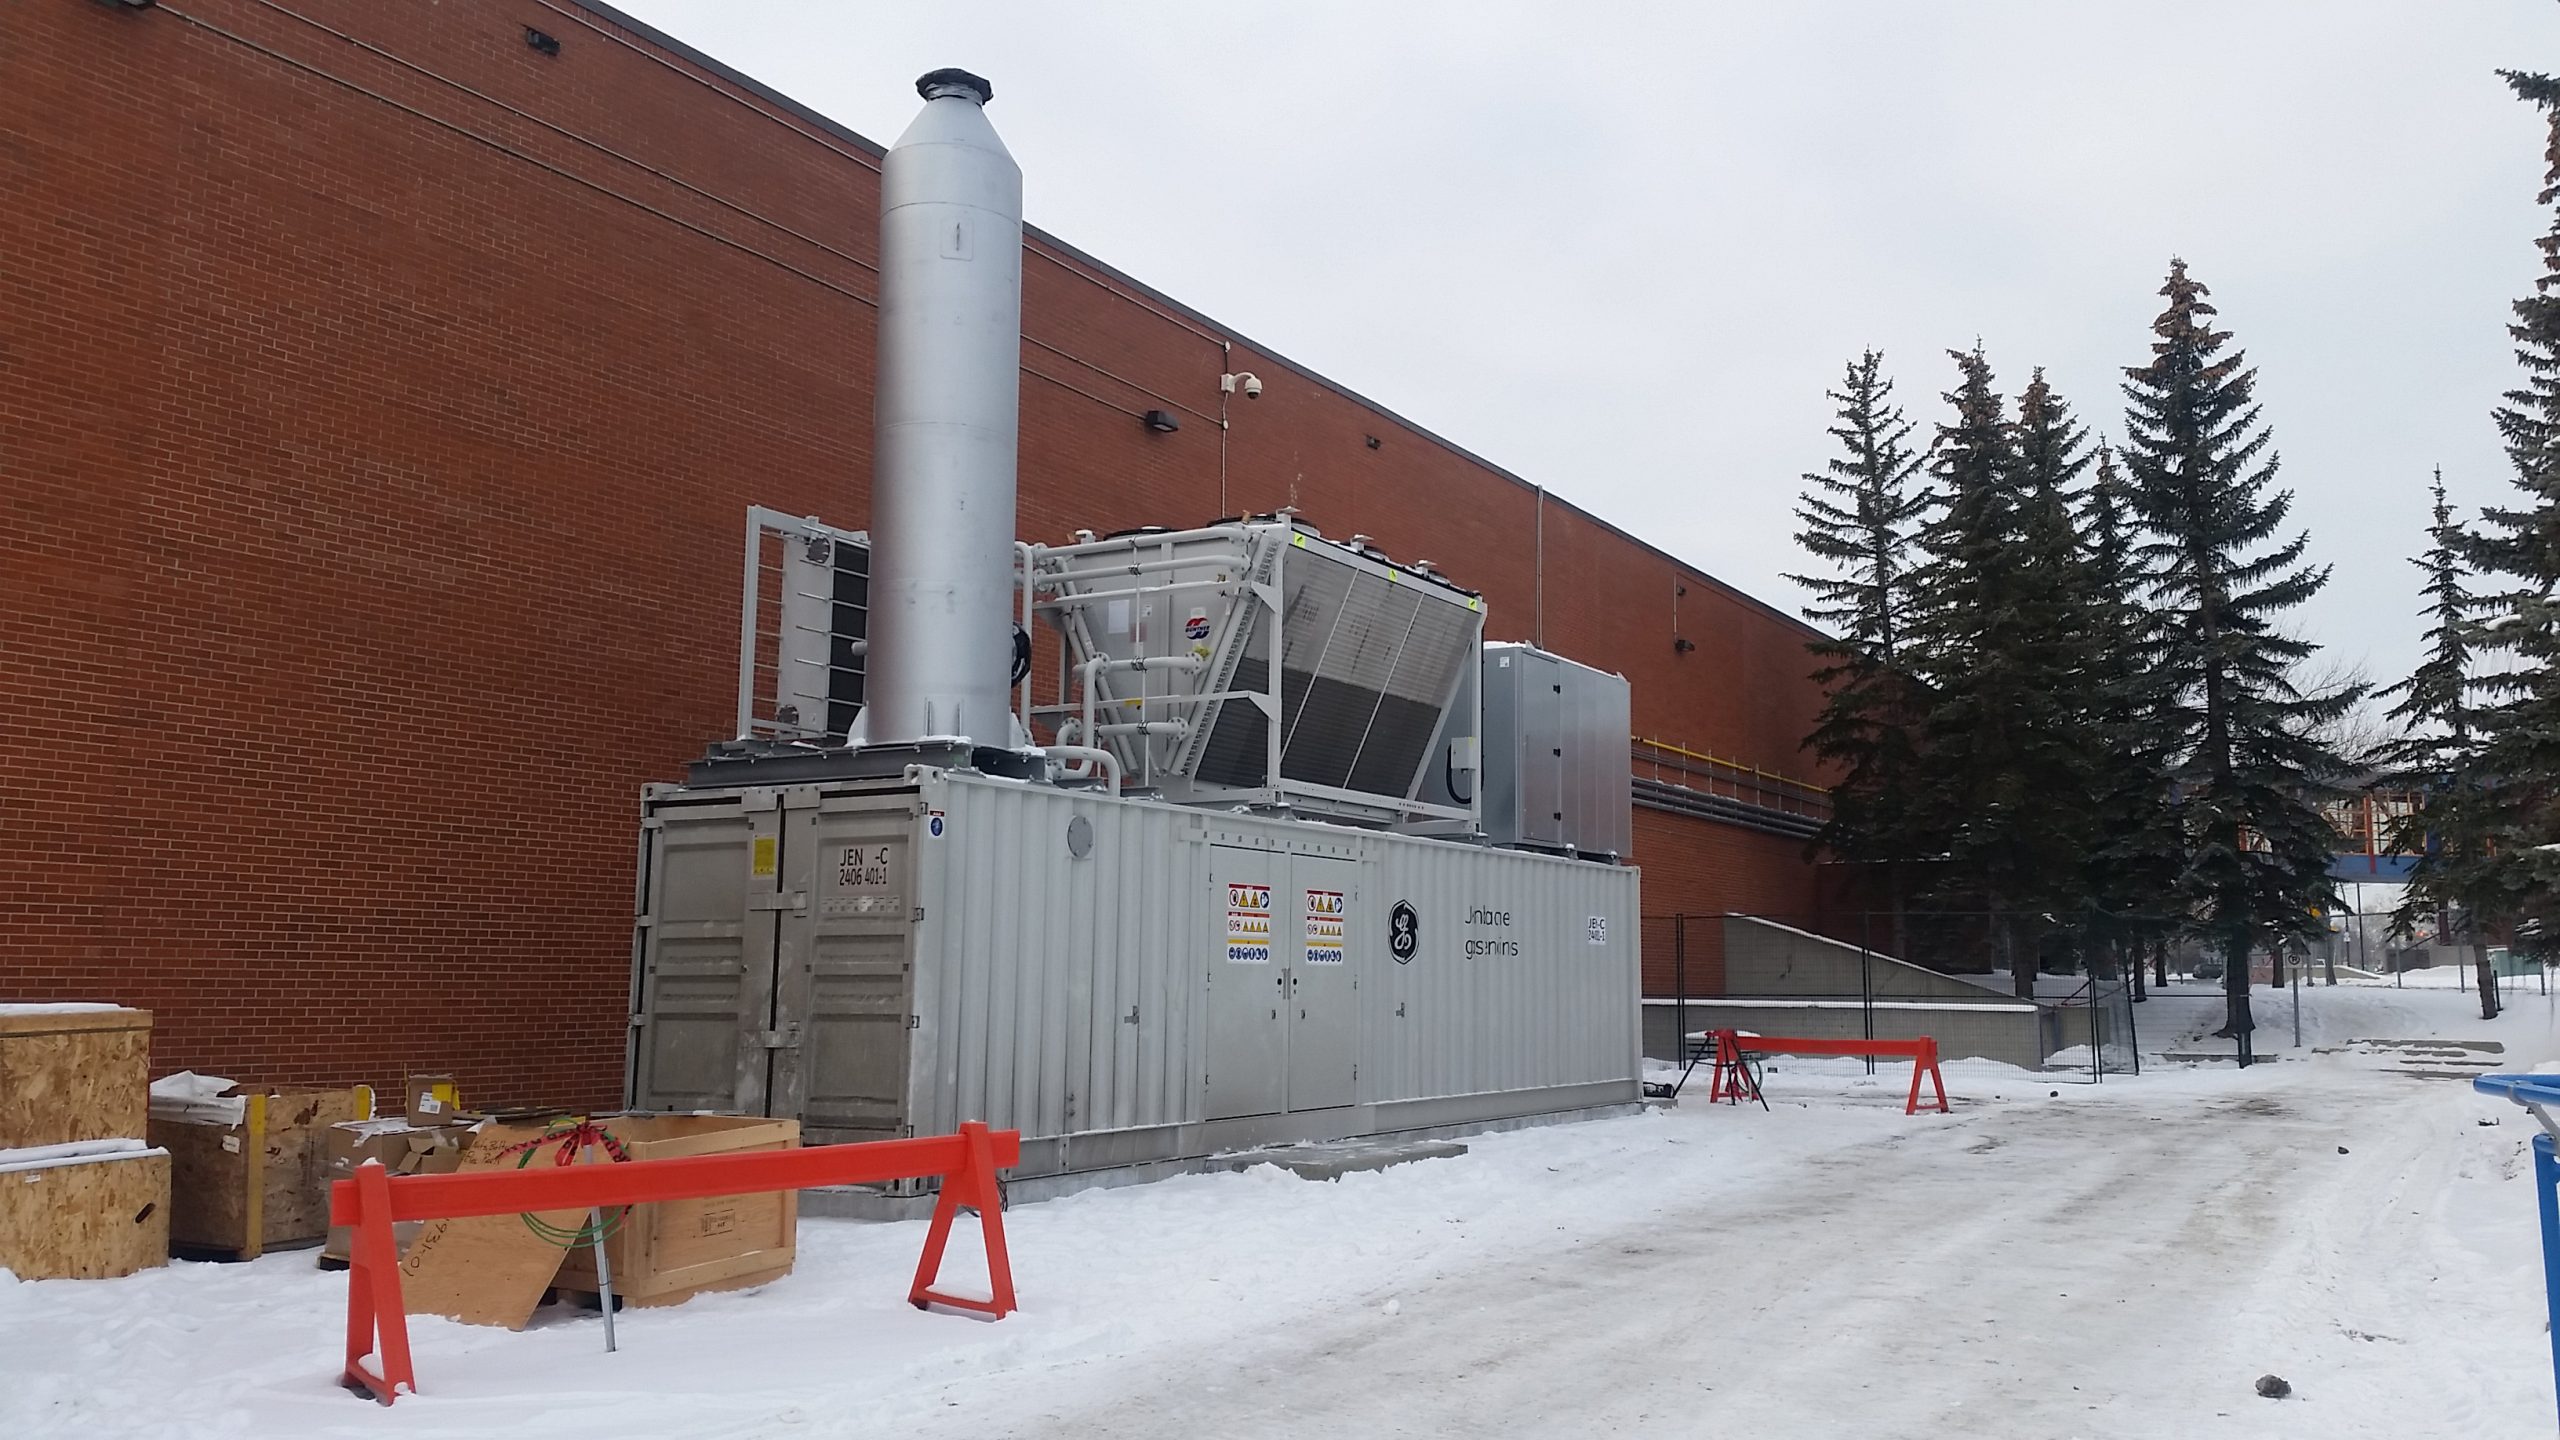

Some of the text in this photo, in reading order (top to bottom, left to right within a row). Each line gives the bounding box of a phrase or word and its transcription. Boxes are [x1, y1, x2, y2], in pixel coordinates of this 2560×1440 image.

[840, 847, 888, 866] JEN -C
[840, 867, 887, 886] 2406 401-1
